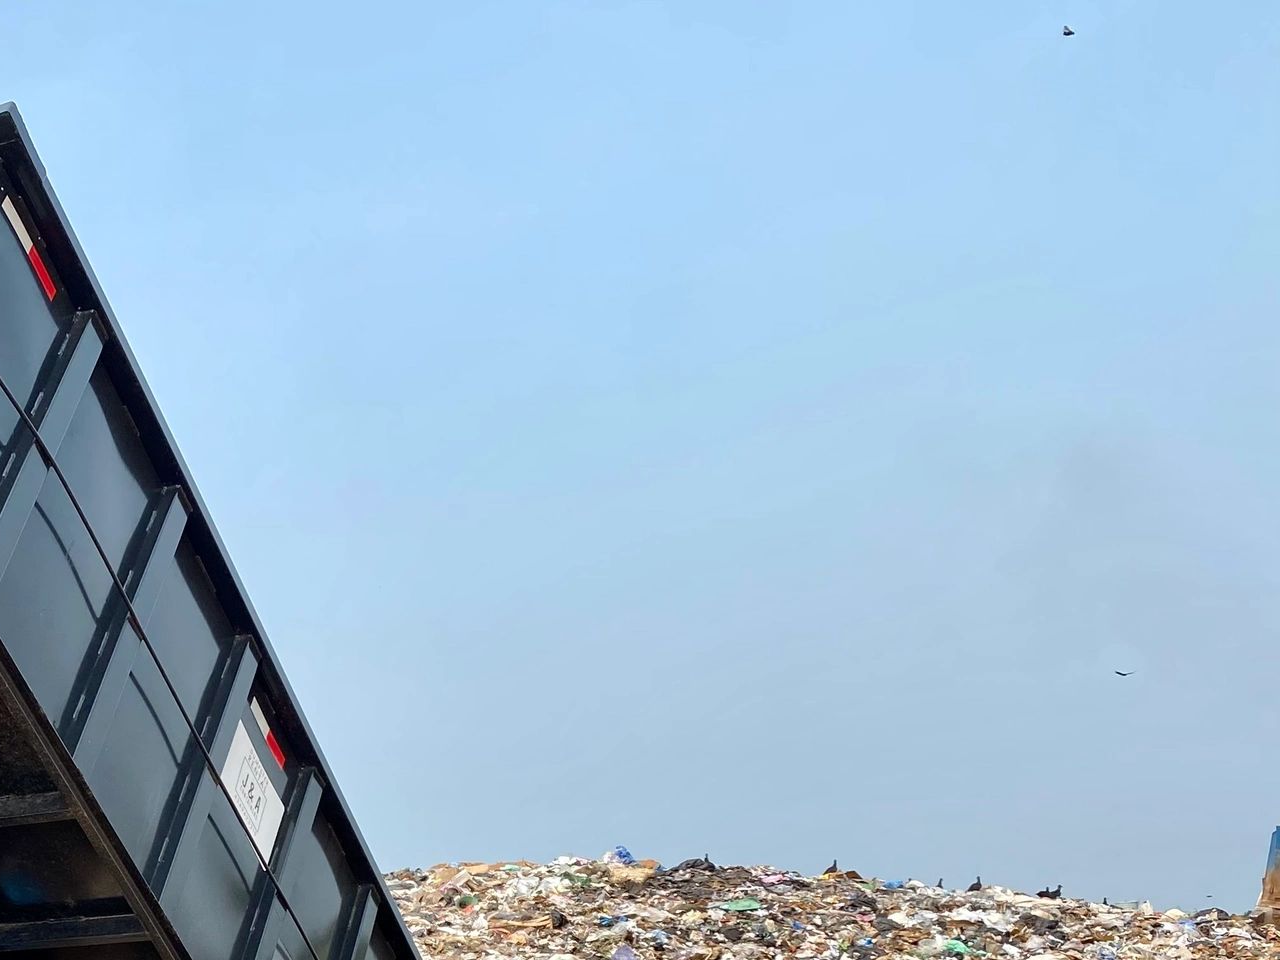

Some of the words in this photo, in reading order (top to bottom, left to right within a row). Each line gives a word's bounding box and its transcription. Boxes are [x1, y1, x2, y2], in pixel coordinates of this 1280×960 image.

[241, 774, 249, 788] J
[247, 782, 254, 799] &
[254, 796, 261, 813] A
